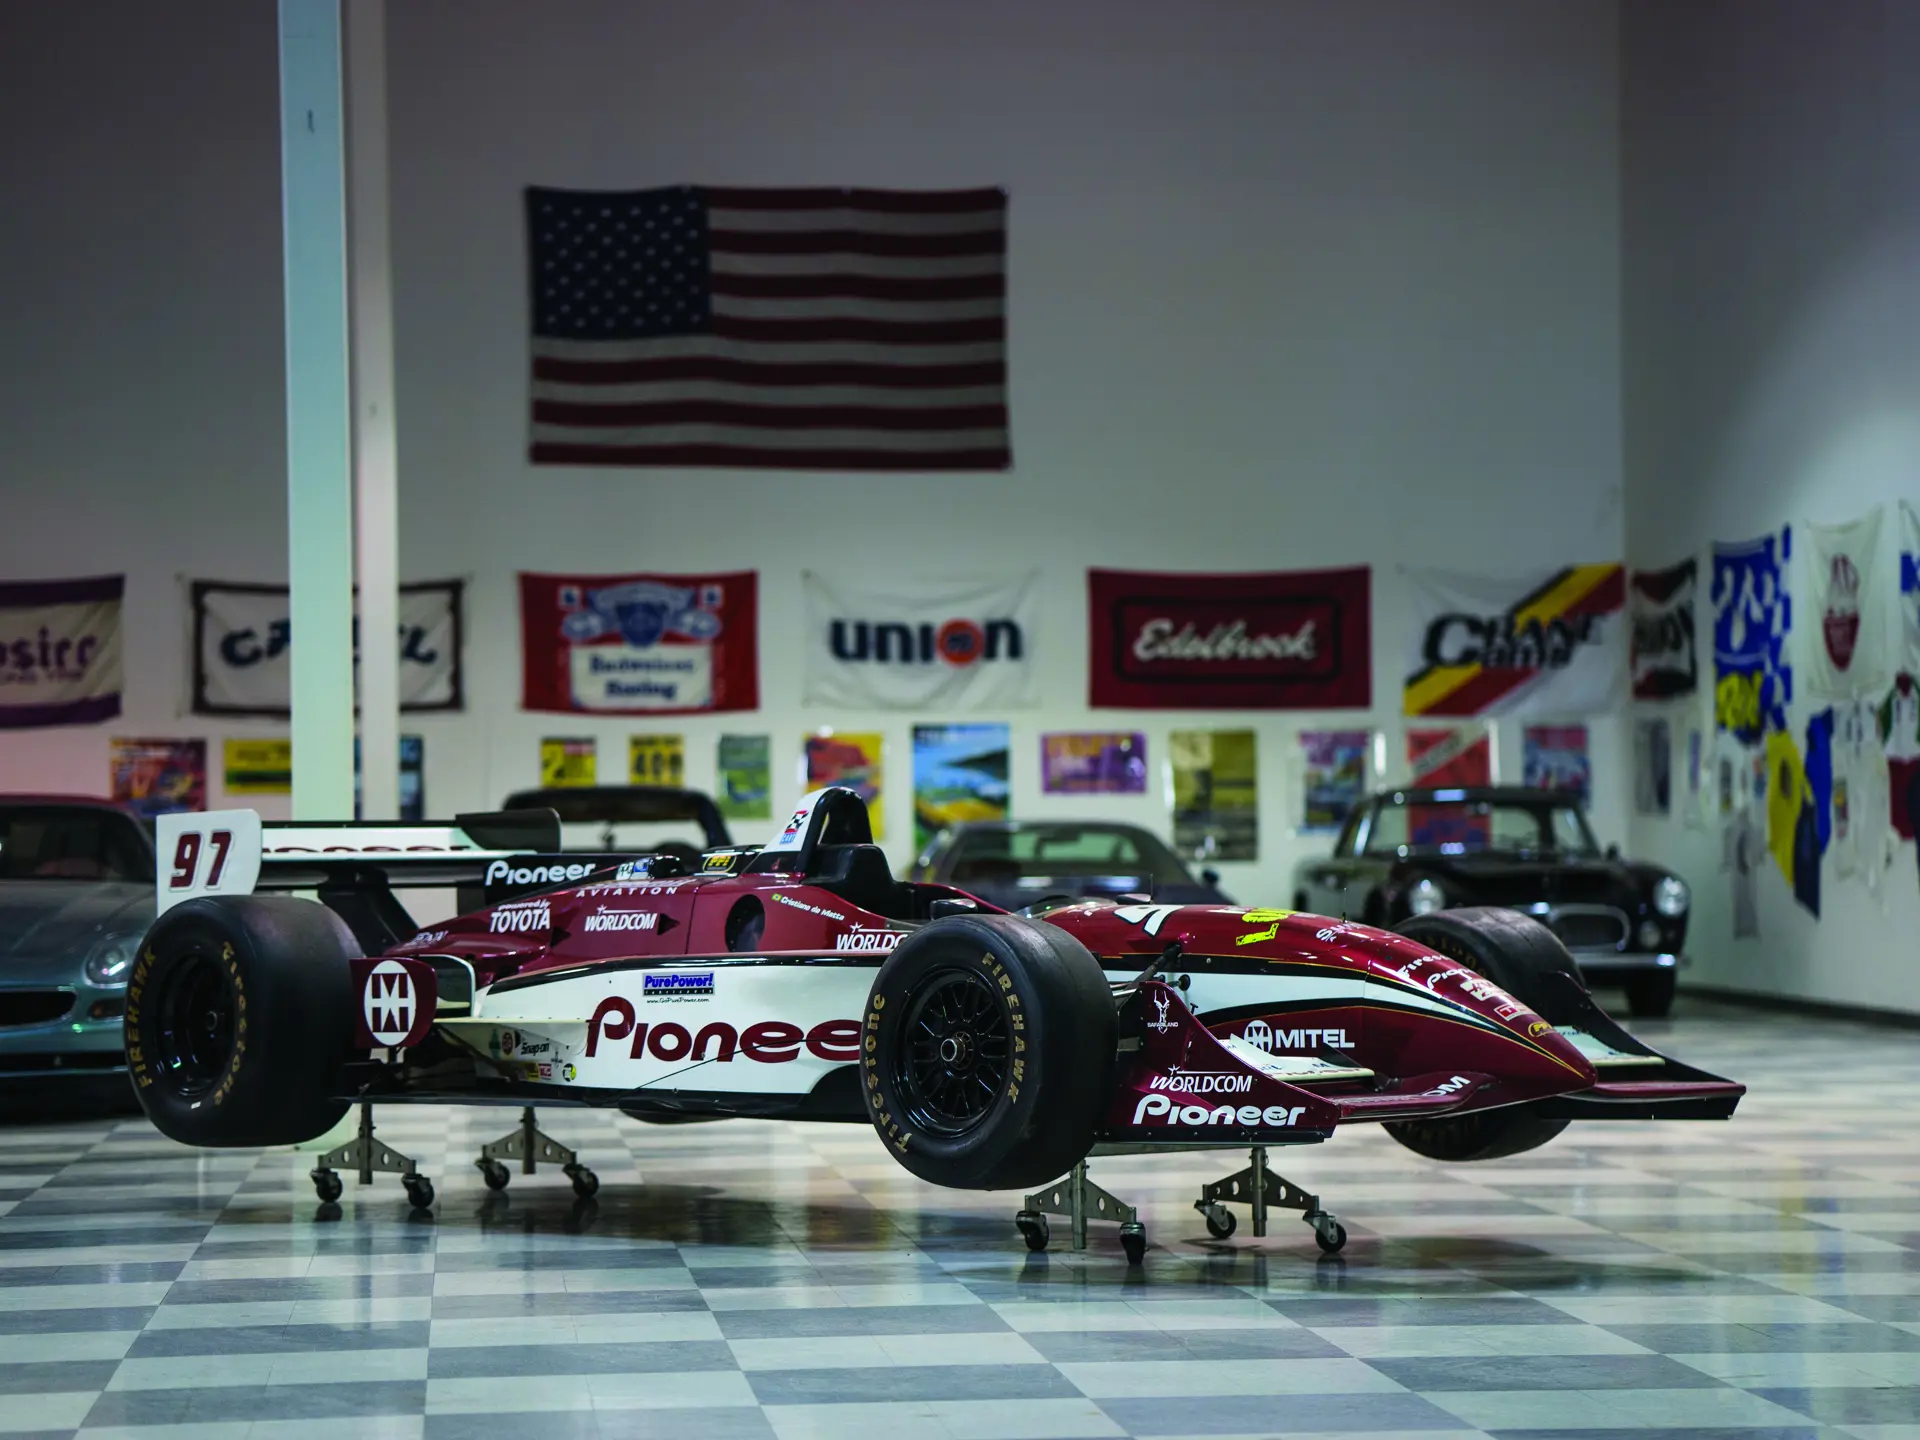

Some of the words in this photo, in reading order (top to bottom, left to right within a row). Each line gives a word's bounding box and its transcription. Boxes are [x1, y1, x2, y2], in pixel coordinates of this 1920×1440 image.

[831, 618, 1023, 668] union
[168, 831, 234, 891] 97
[485, 860, 596, 886] Pioneer
[576, 887, 678, 898] AVIATION
[498, 900, 541, 910] powered
[780, 896, 812, 912] Cristiano
[490, 909, 551, 933] TOYOTA
[584, 913, 658, 932] WORLDCOM
[644, 973, 714, 988] PurePower!
[981, 952, 1026, 1104] FIREHAWK
[1275, 1029, 1355, 1048] MITEL
[521, 1042, 550, 1056] Snap-on
[865, 993, 913, 1153] Firestone
[1150, 1075, 1252, 1092] WORLDCOM
[1133, 1094, 1306, 1126] Pioneer
